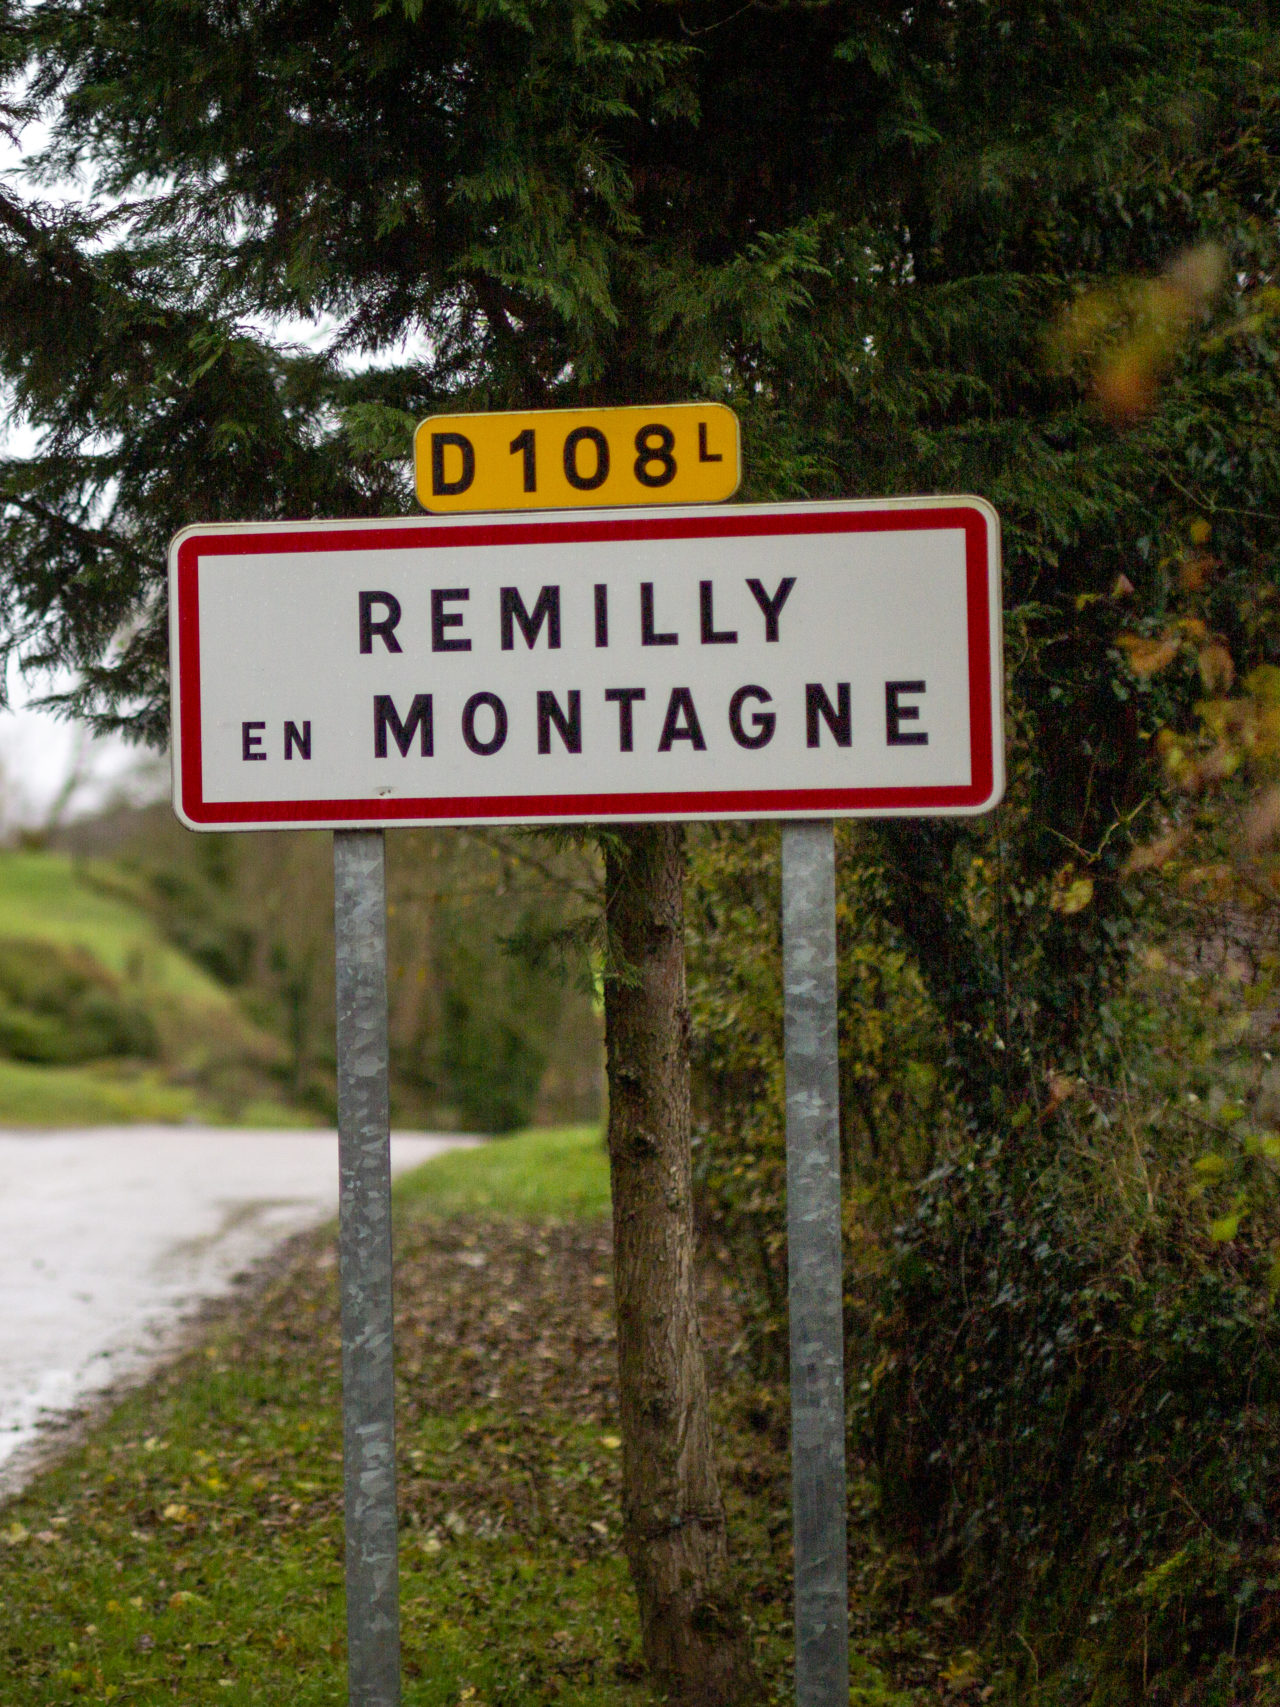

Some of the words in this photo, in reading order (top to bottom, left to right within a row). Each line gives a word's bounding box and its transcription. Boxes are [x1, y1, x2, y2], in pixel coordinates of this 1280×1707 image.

[430, 432, 476, 497] D
[358, 576, 798, 655] REMILLY
[241, 720, 312, 762] EN
[373, 679, 929, 759] MONTAGNE
